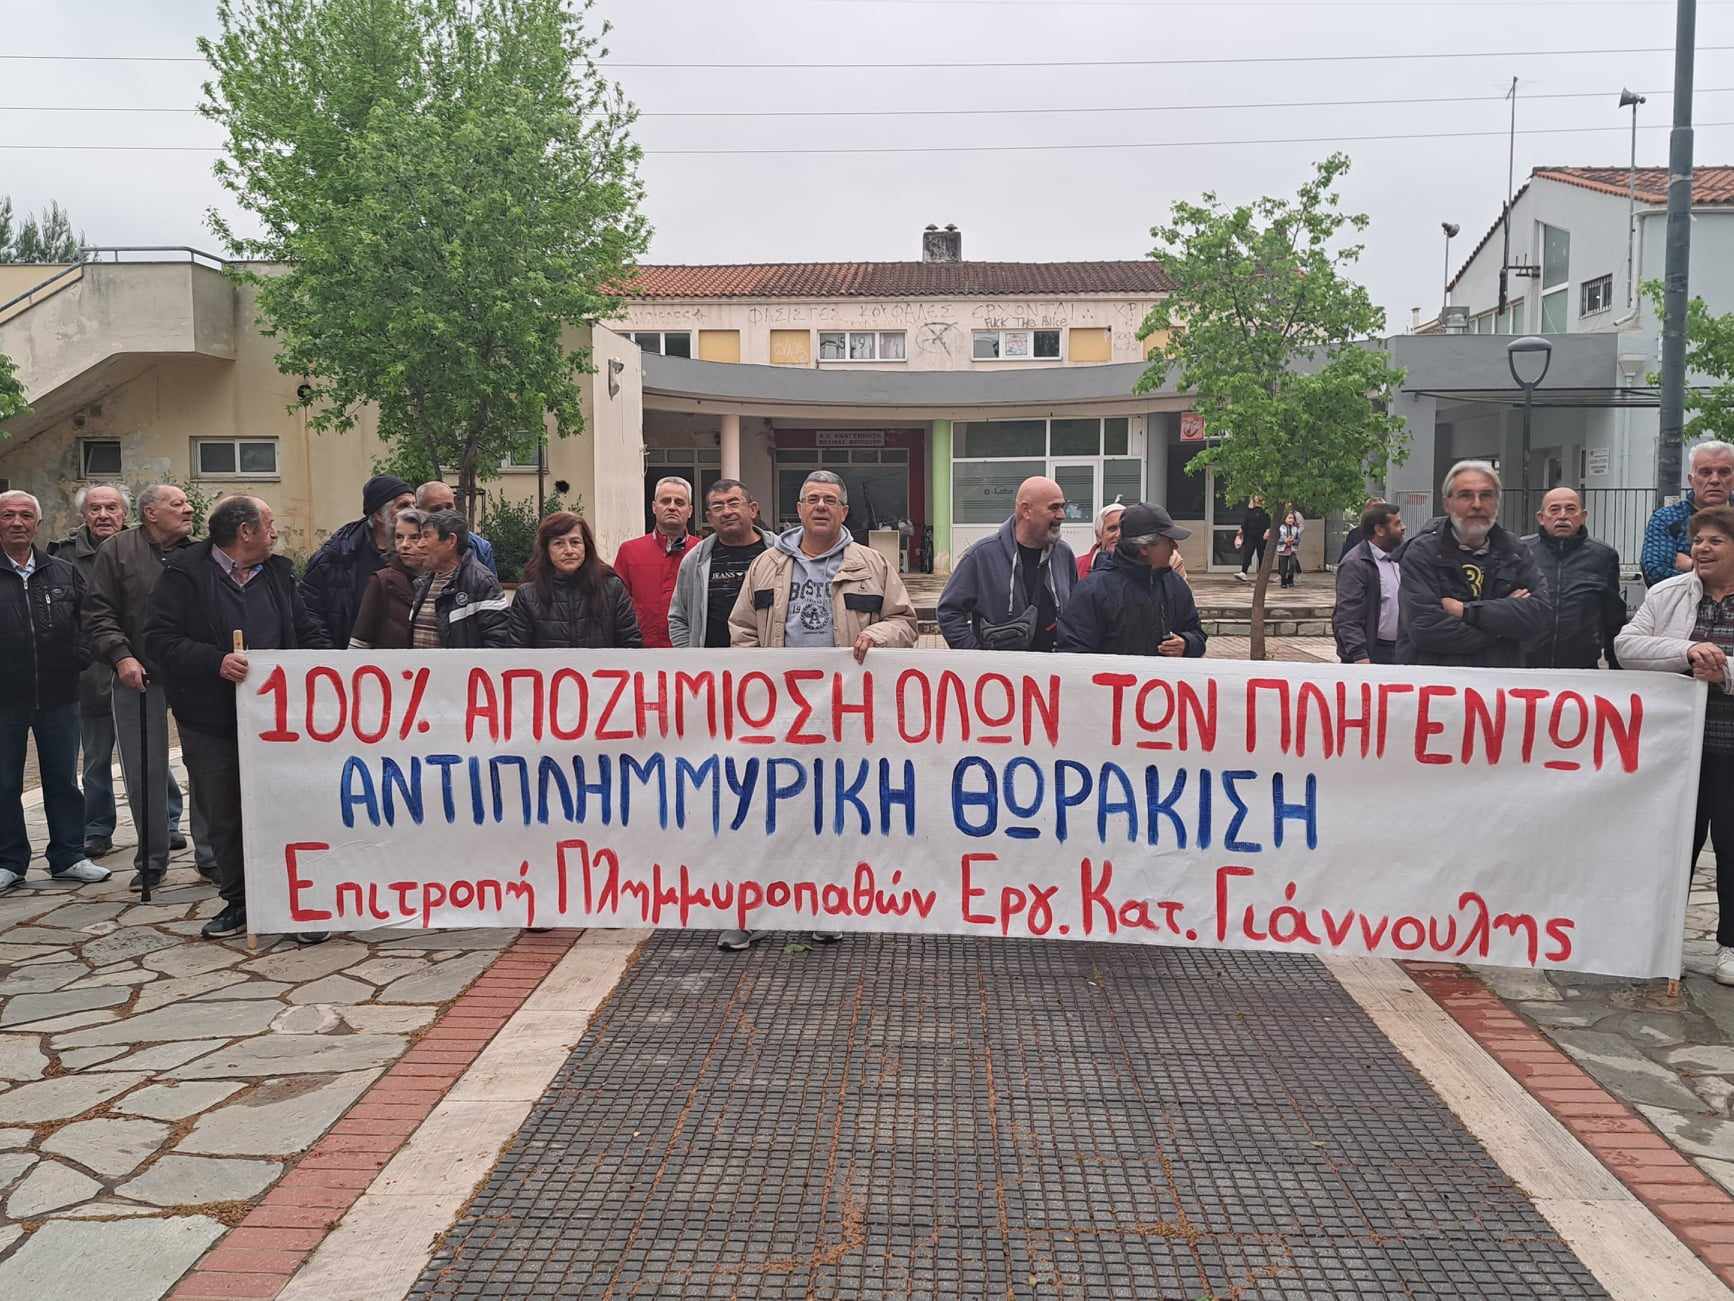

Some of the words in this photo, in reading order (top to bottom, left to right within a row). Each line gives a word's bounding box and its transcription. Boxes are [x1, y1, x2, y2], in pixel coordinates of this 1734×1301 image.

[259, 665, 431, 744] 100%
[465, 667, 876, 745] ΑΠΟΖΗΜΙΩΣΗ
[895, 667, 1061, 746] ΟΛΩΝ
[1091, 671, 1218, 753] ΤΩΝ
[1245, 677, 1644, 774] ΠΛΗΓΕΝΤΩΝ
[340, 752, 917, 837] ΑΝΤΙΠΛΗΜΜΥΡΙΚΗ
[951, 756, 1319, 853] ΘΩΡΑΚΙΣΗ
[285, 841, 536, 929] Επιτροπή
[556, 839, 937, 930] Πλημμυροπαθών
[1215, 865, 1576, 965] Γιάννουλης
